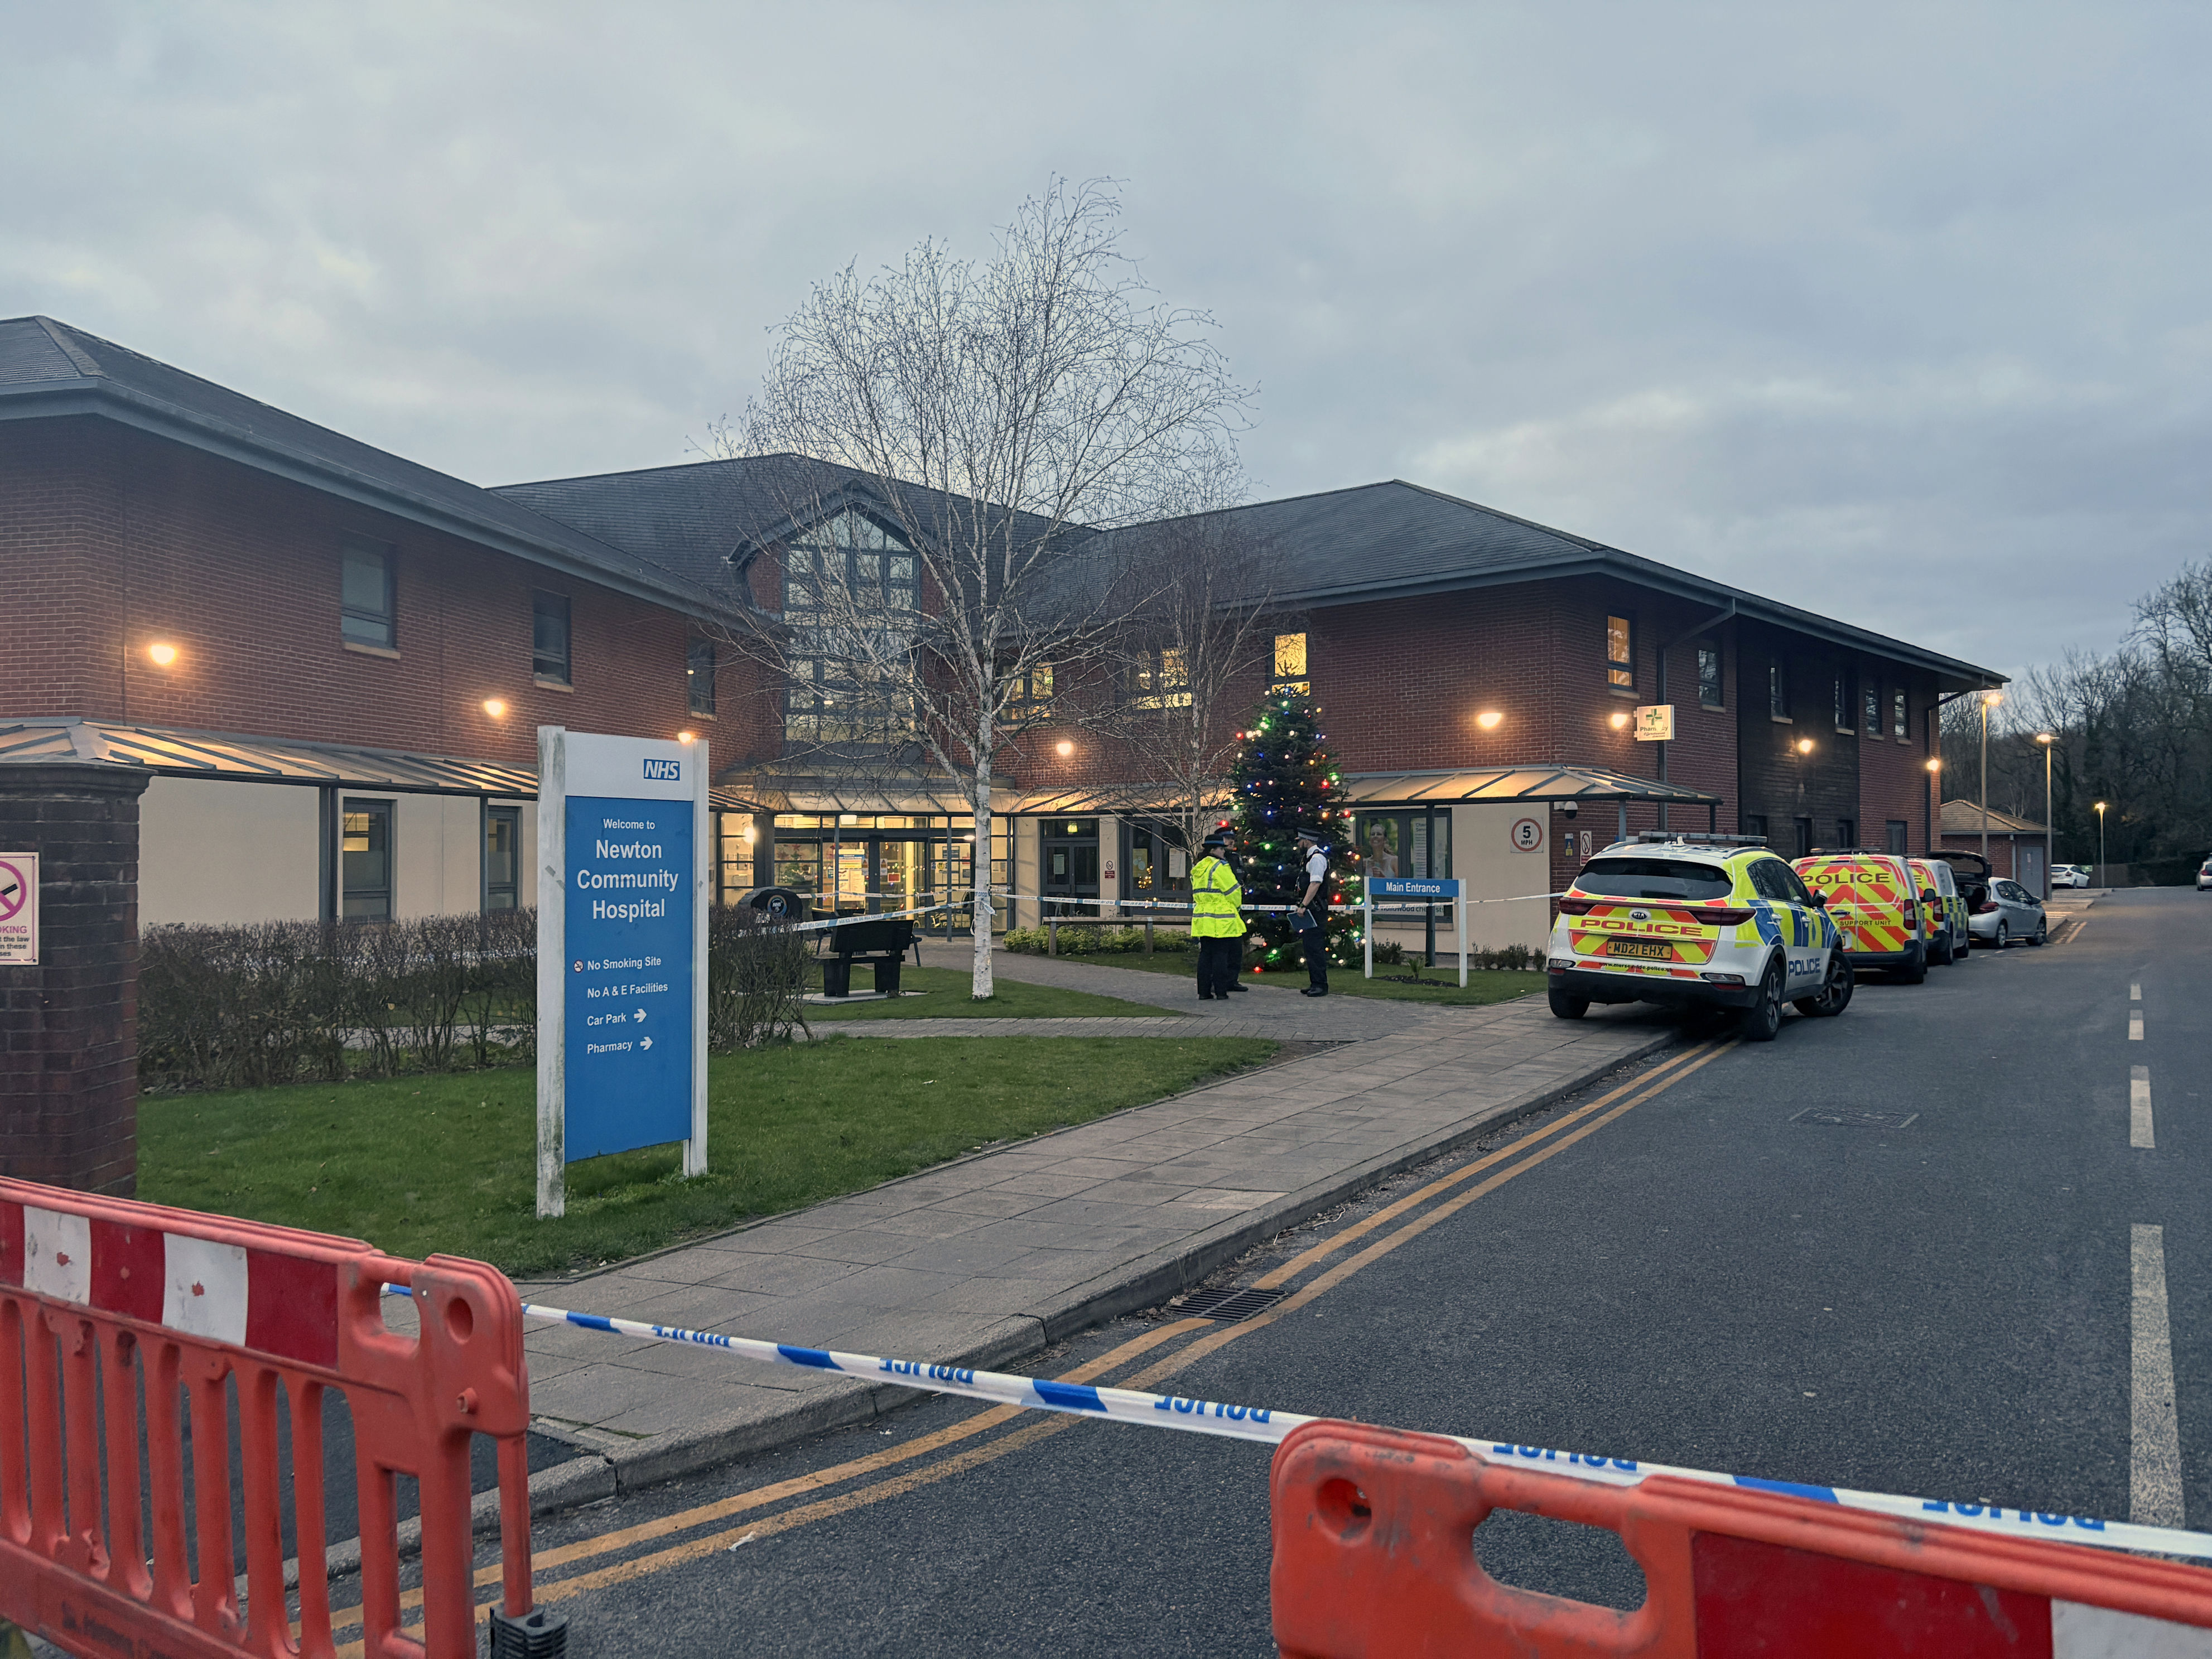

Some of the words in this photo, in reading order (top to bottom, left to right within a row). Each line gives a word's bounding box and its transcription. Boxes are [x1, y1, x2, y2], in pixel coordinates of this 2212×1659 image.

[644, 760, 679, 780] NHS
[603, 818, 644, 830] Welcome
[647, 821, 656, 830] to
[1523, 826, 1531, 838] 5
[596, 840, 662, 859] Newton
[577, 869, 678, 892] Community
[1800, 873, 1890, 884] POLICE
[1386, 882, 1404, 892] Main
[1406, 882, 1440, 893] Entrance
[593, 899, 664, 923] Hospital
[1580, 919, 1702, 937] POLICE
[1613, 943, 1638, 954] MD21
[1642, 944, 1664, 956] EHX
[587, 960, 600, 971] No
[603, 958, 642, 970] Smoking
[645, 956, 662, 967] Site
[1788, 958, 1820, 977] POLICE
[587, 988, 601, 999] No
[603, 987, 610, 997] A
[612, 986, 619, 996] &
[621, 985, 627, 995] E
[630, 982, 668, 995] Facilities
[587, 1015, 604, 1026] Car
[606, 1012, 627, 1024] Park
[587, 1041, 633, 1054] Pharmacy
